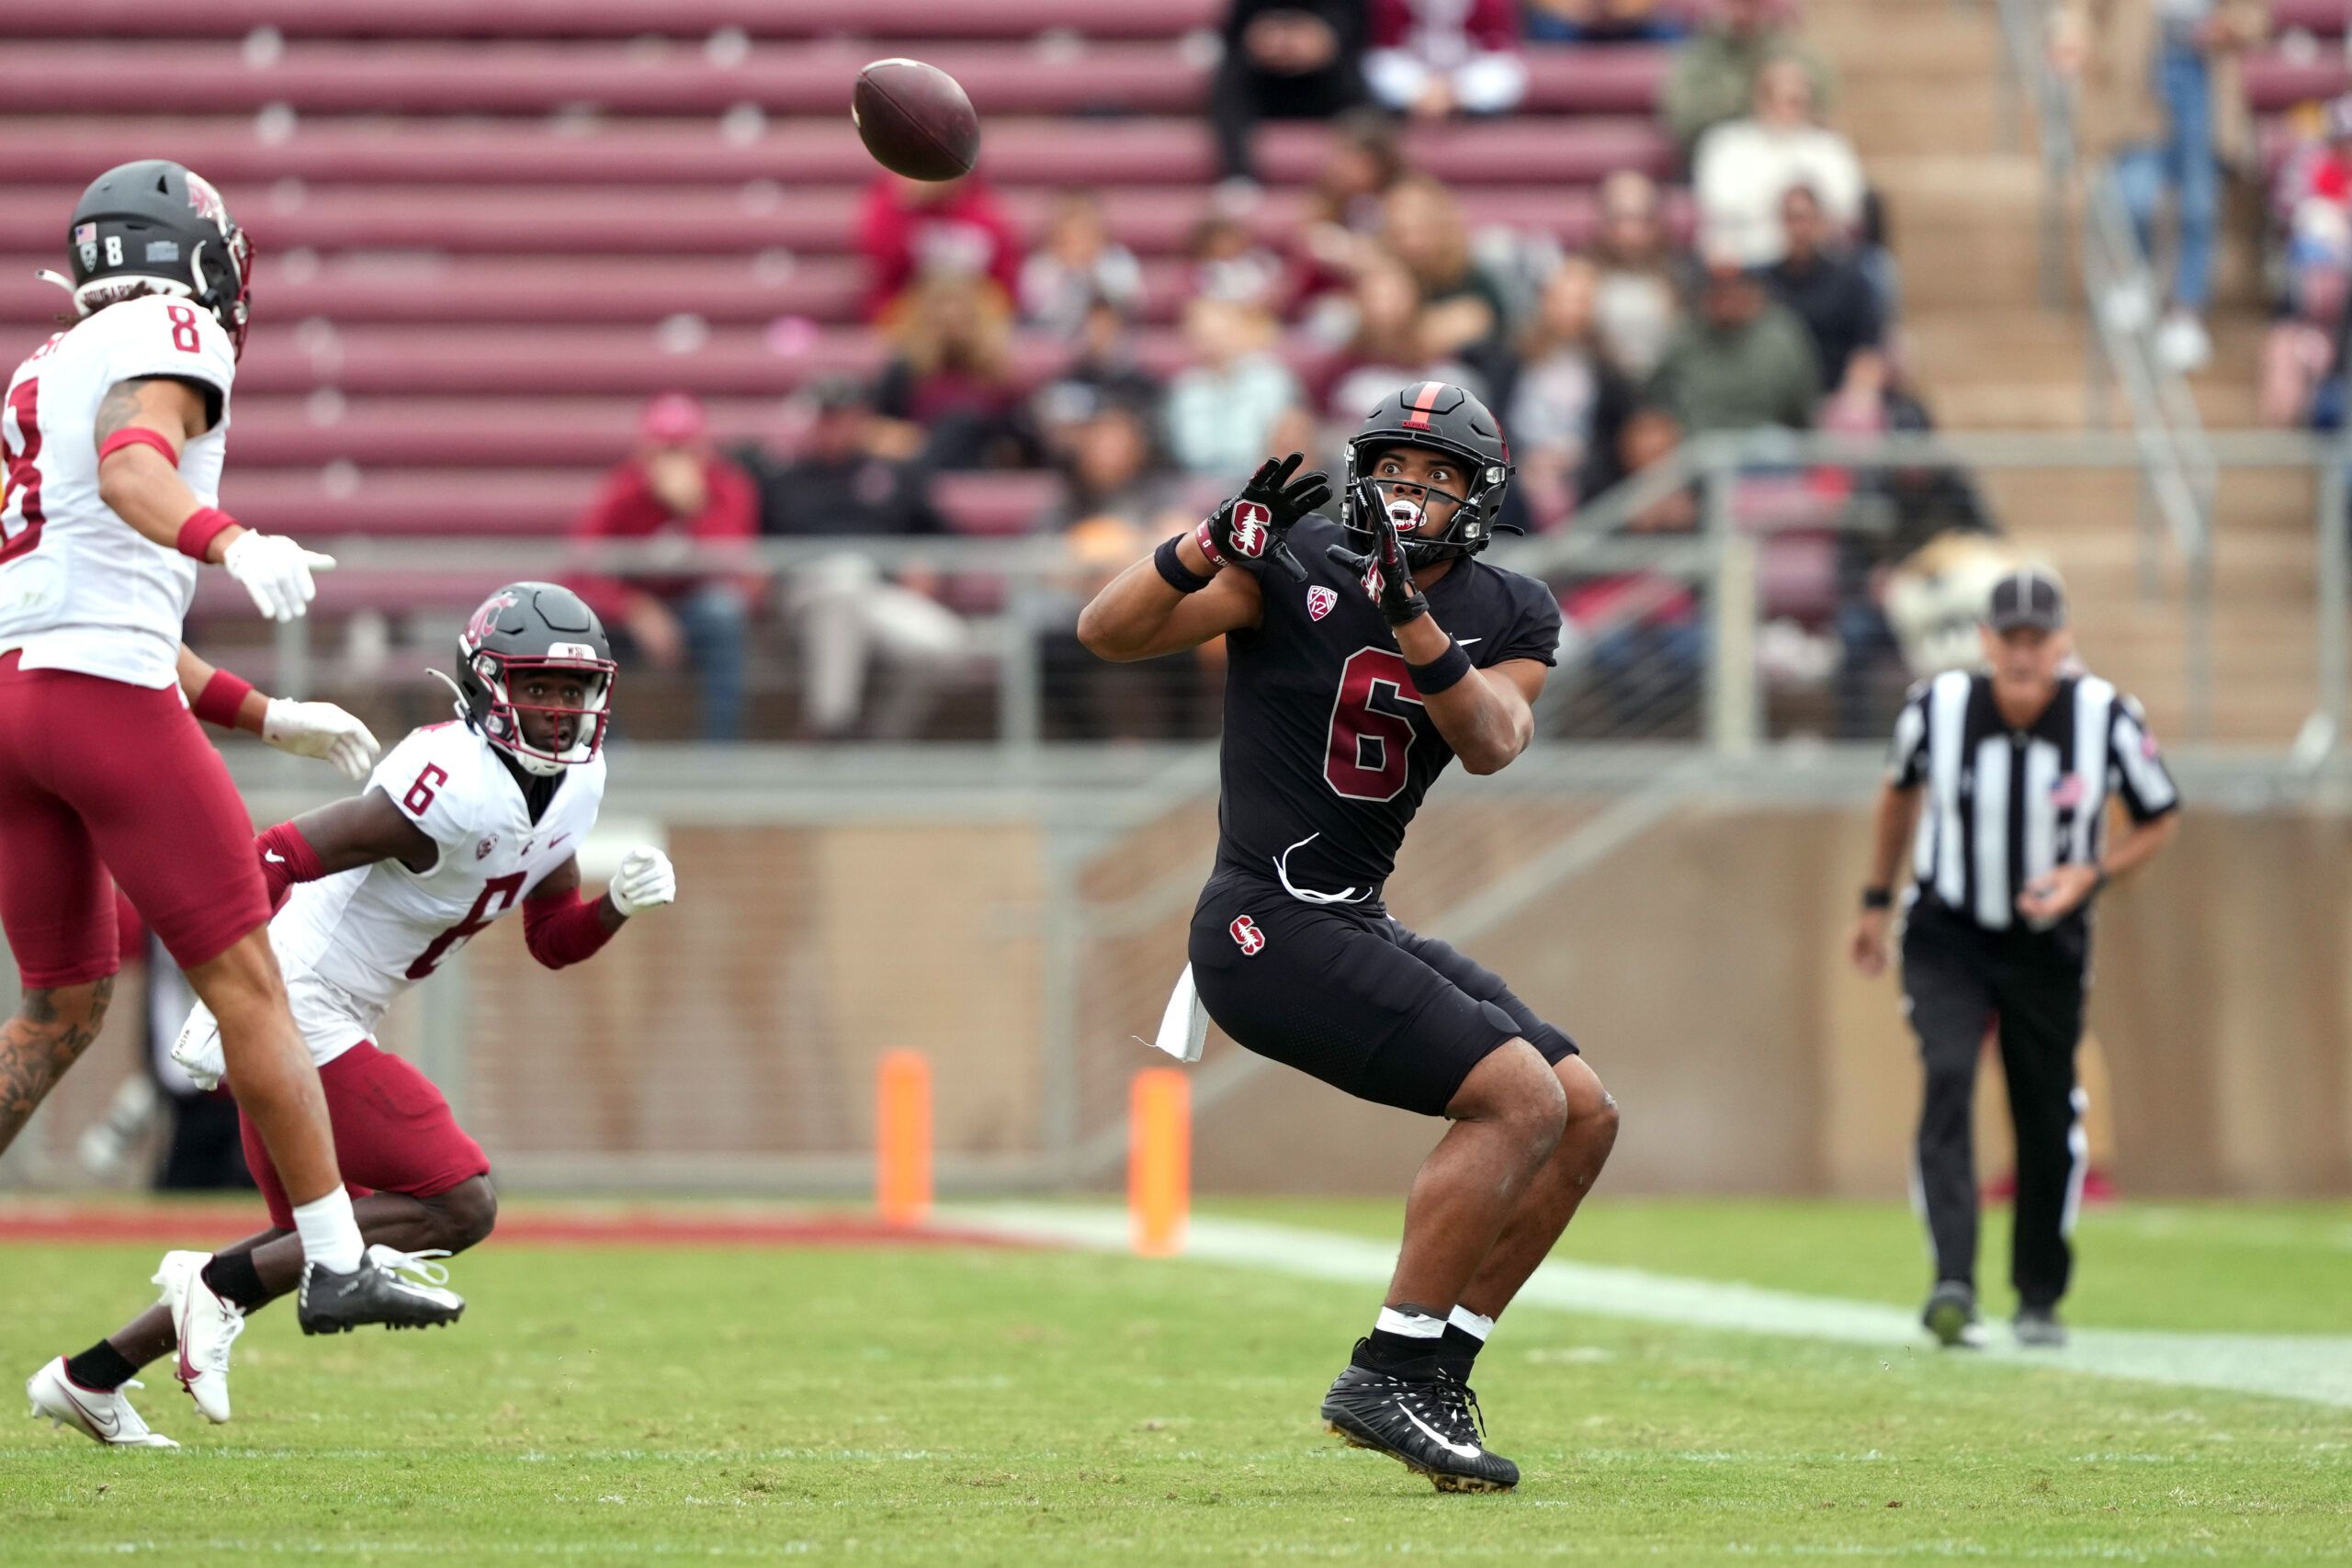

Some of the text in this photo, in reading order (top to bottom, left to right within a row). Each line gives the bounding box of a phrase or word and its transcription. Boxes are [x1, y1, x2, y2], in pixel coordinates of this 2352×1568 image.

[105, 236, 123, 266] 8
[166, 306, 200, 353] 8
[0, 377, 47, 566] 8
[1308, 588, 1337, 610] PAC
[1311, 601, 1327, 615] 12
[1323, 646, 1425, 802] 6
[403, 761, 448, 817] 6
